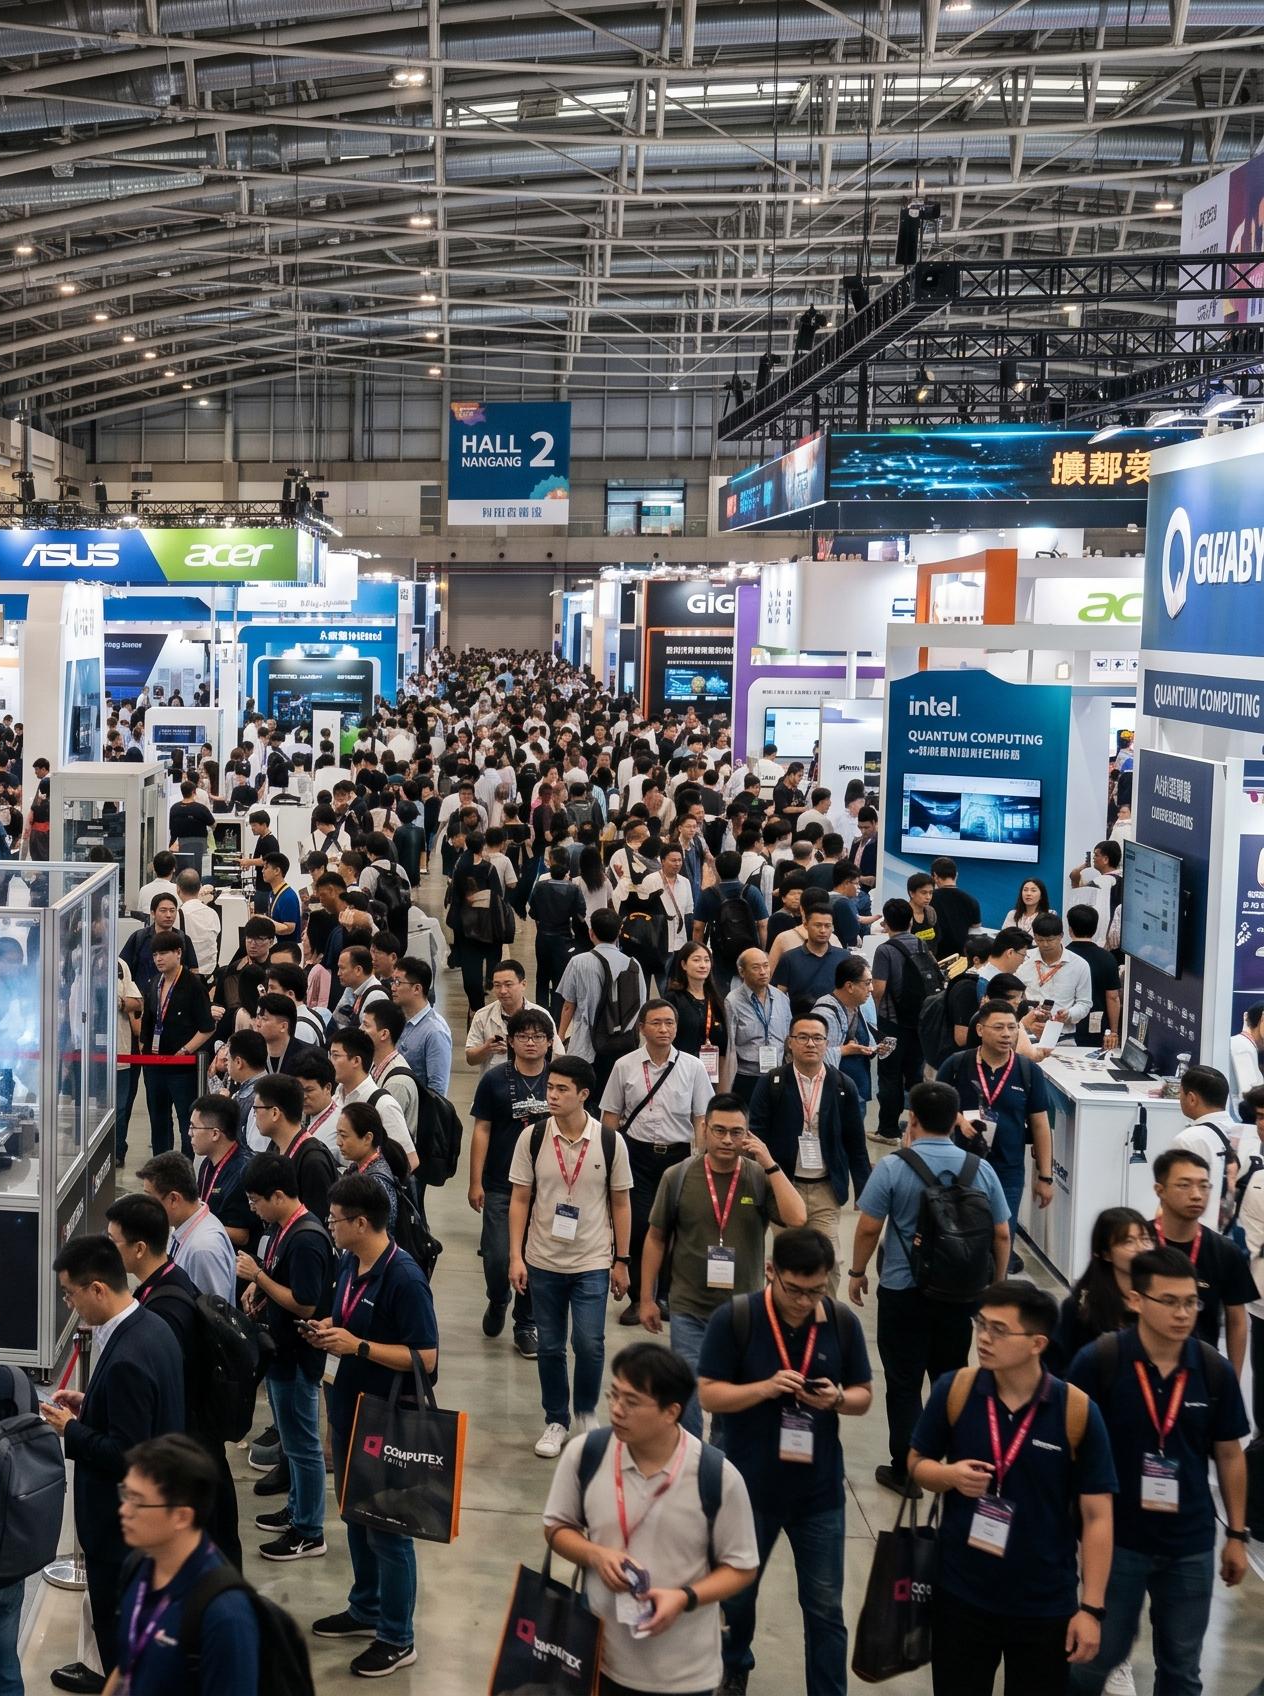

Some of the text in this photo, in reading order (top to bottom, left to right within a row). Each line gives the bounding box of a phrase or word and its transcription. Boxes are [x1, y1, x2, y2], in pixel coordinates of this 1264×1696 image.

[462, 430, 556, 468] HALL 2
[461, 456, 522, 468] NANGANG
[22, 543, 120, 567] ASUS
[184, 543, 275, 567] acer
[1154, 683, 1261, 719] QUANTUM COMPUTING
[908, 729, 1044, 746] QUANTUM COMPUTING
